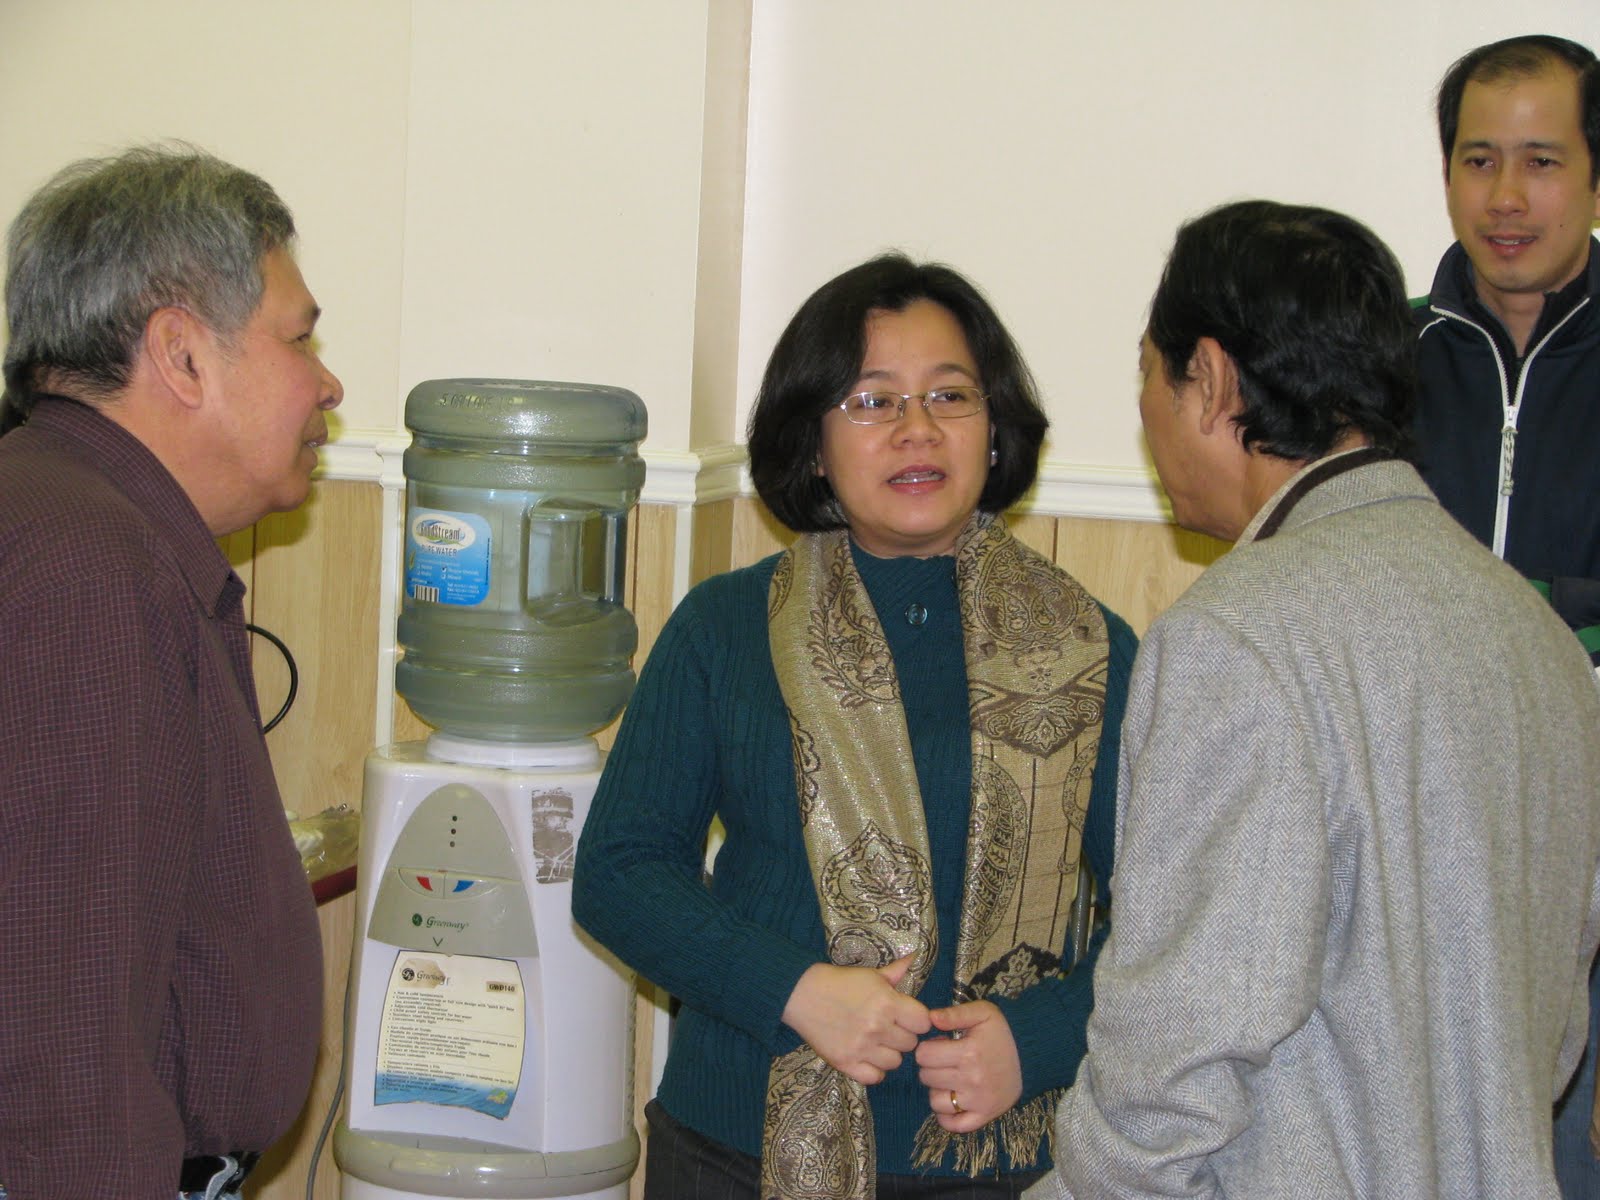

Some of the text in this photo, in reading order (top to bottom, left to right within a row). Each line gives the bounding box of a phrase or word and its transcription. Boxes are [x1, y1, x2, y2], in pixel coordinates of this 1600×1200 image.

[436, 547, 457, 557] WATER
[426, 916, 466, 933] Greenway
[488, 984, 515, 993] GWD140
